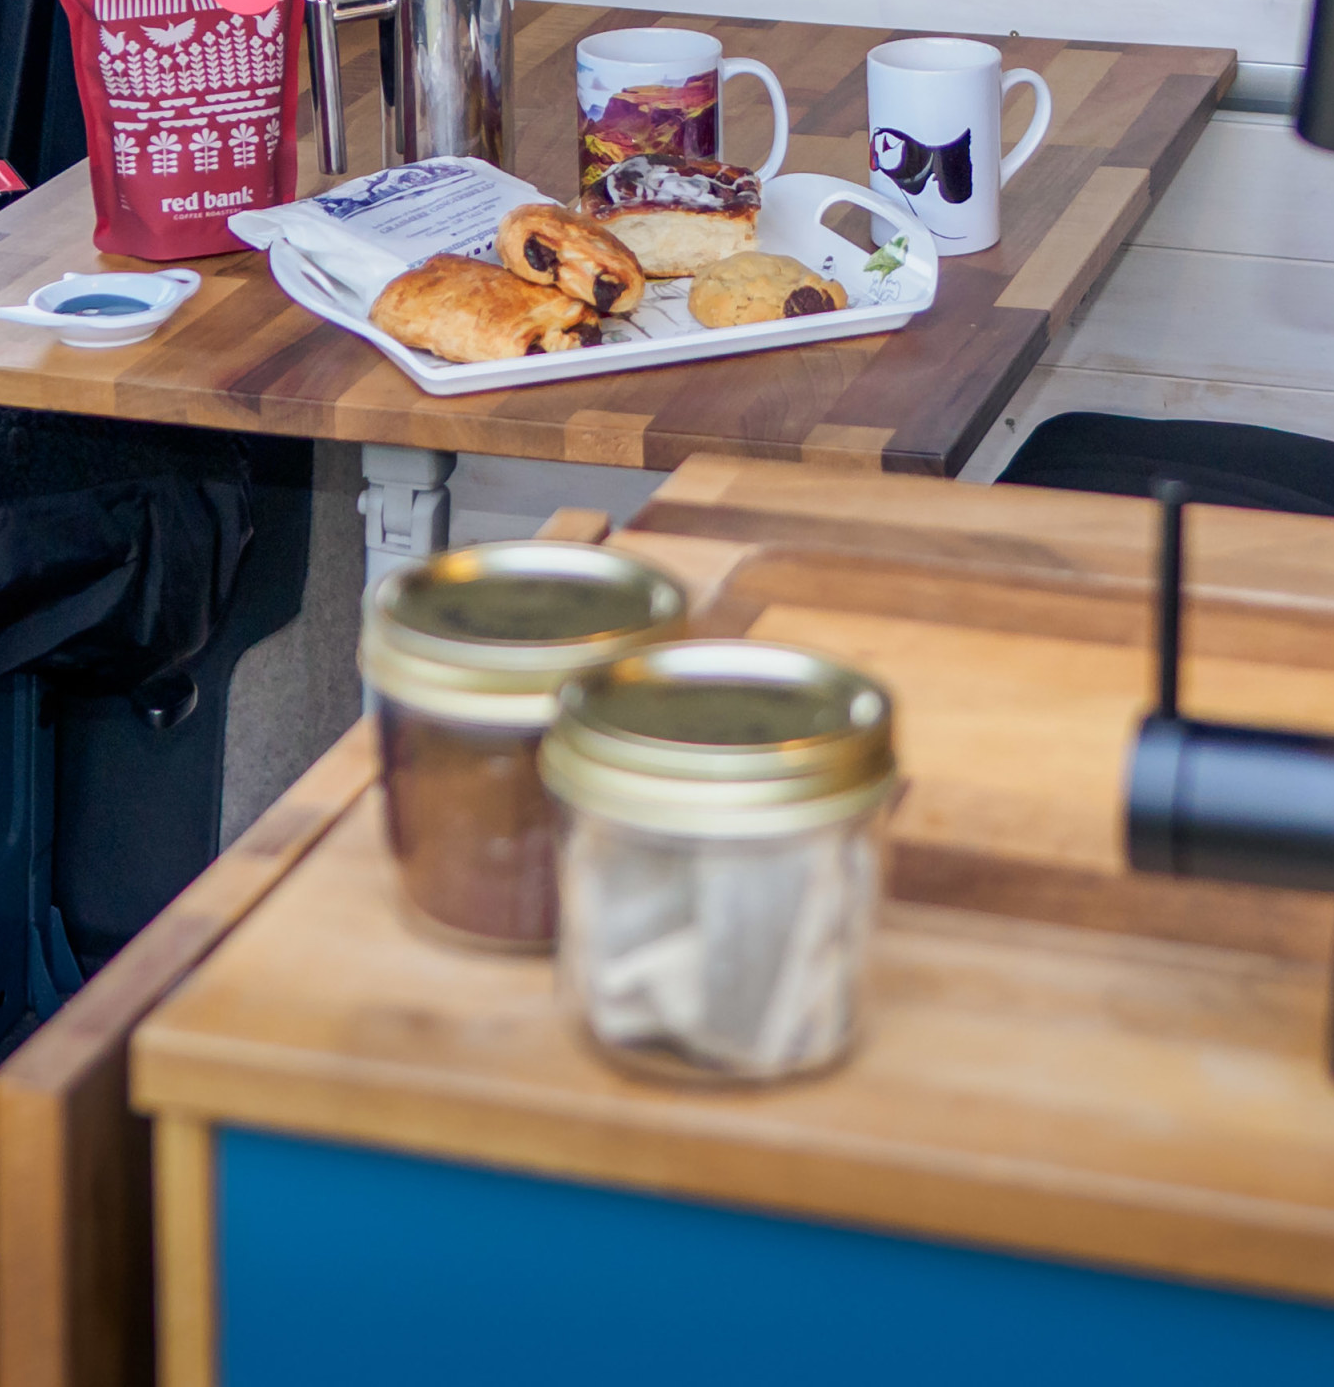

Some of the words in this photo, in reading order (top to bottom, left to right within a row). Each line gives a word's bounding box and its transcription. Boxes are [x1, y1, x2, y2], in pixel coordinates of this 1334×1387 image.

[161, 192, 199, 213] red
[204, 185, 254, 210] bank
[172, 213, 203, 221] COFFEE
